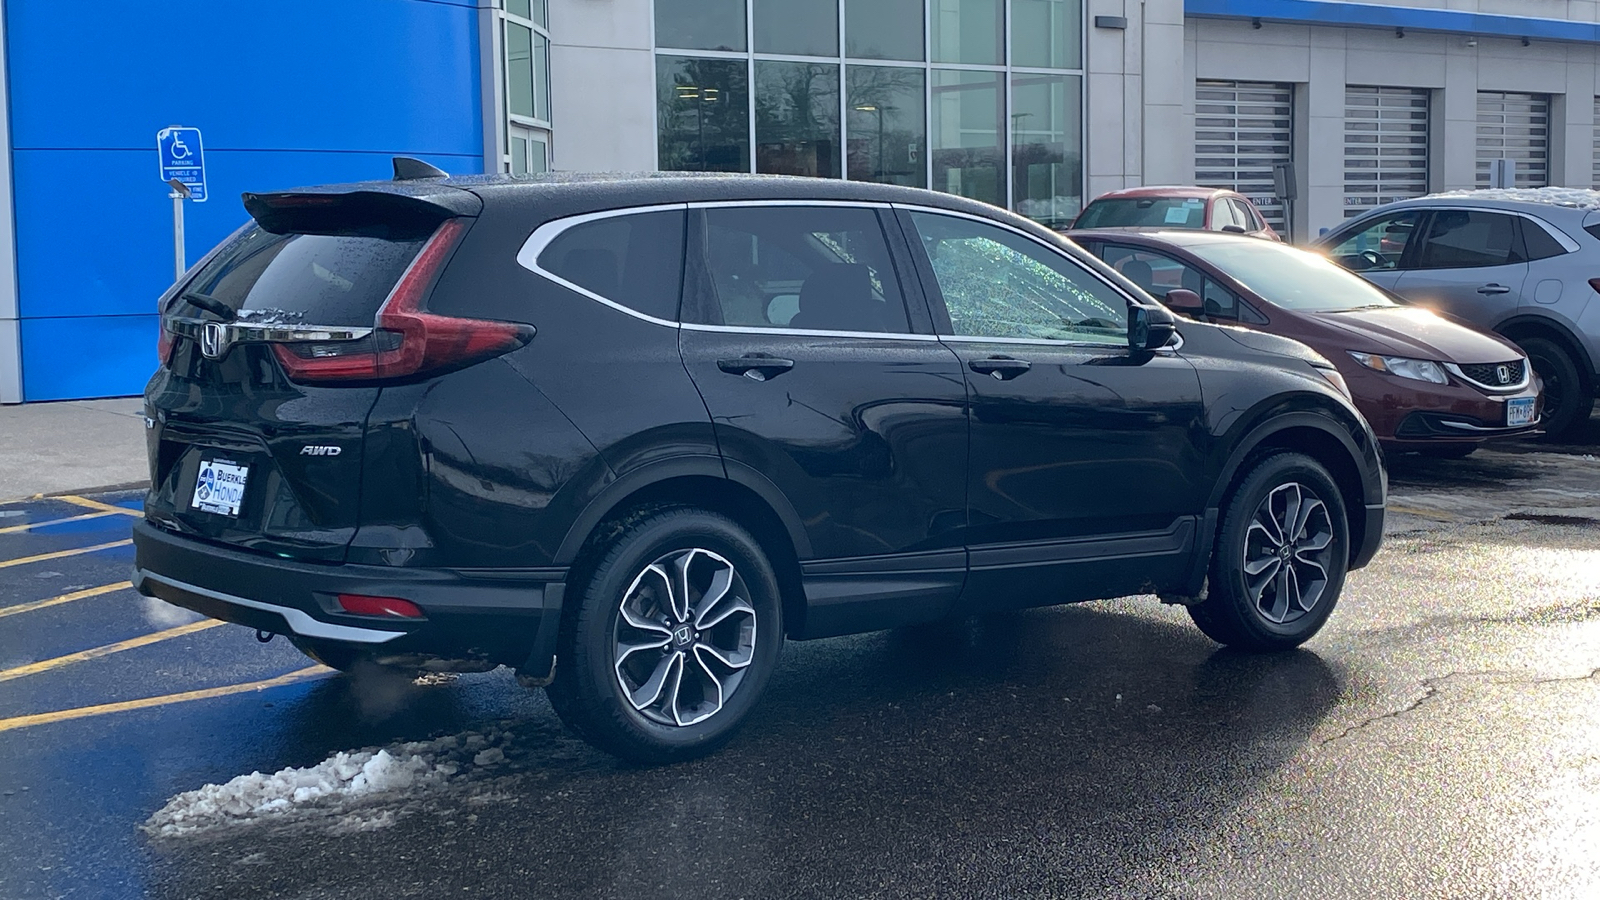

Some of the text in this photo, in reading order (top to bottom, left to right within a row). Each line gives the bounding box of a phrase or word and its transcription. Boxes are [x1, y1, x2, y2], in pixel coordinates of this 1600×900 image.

[1252, 197, 1272, 205] ENTER
[299, 445, 342, 456] AWD
[216, 469, 247, 485] BUERKLE
[212, 481, 244, 503] HONDA
